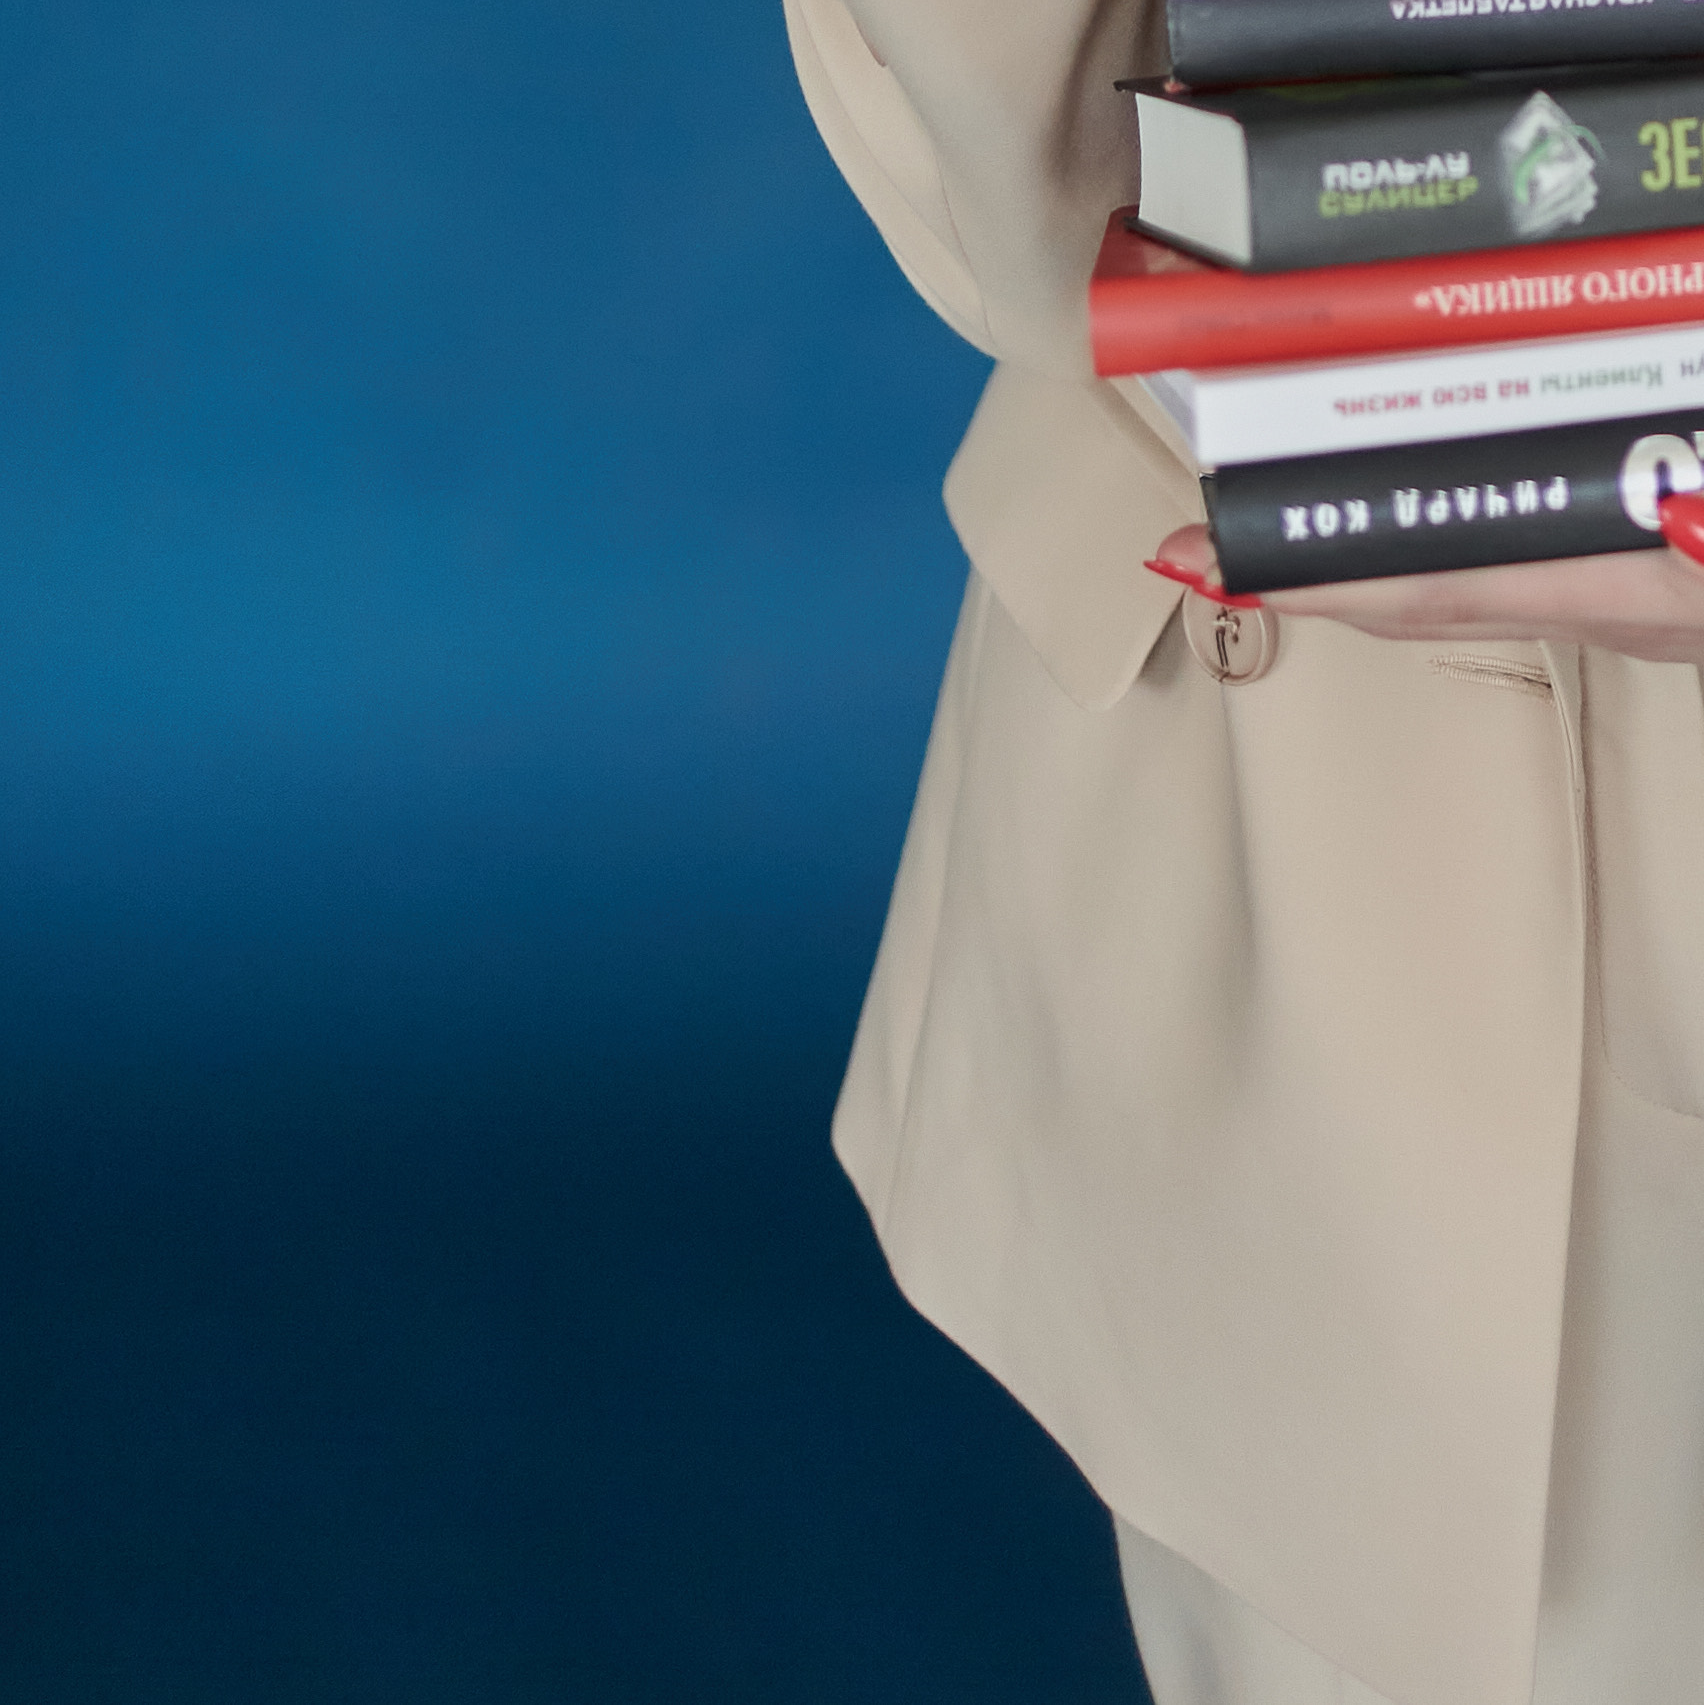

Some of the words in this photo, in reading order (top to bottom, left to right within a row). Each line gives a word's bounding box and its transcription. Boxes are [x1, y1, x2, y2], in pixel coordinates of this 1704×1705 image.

[1415, 273, 1576, 317] ЯЩИКА»
[1499, 378, 1530, 399] на
[1540, 363, 1664, 393] Клиенты
[1333, 392, 1423, 417] жизнь
[1432, 384, 1488, 407] всю
[1394, 476, 1569, 528] РИЧАРД
[1283, 499, 1370, 542] КОХ
